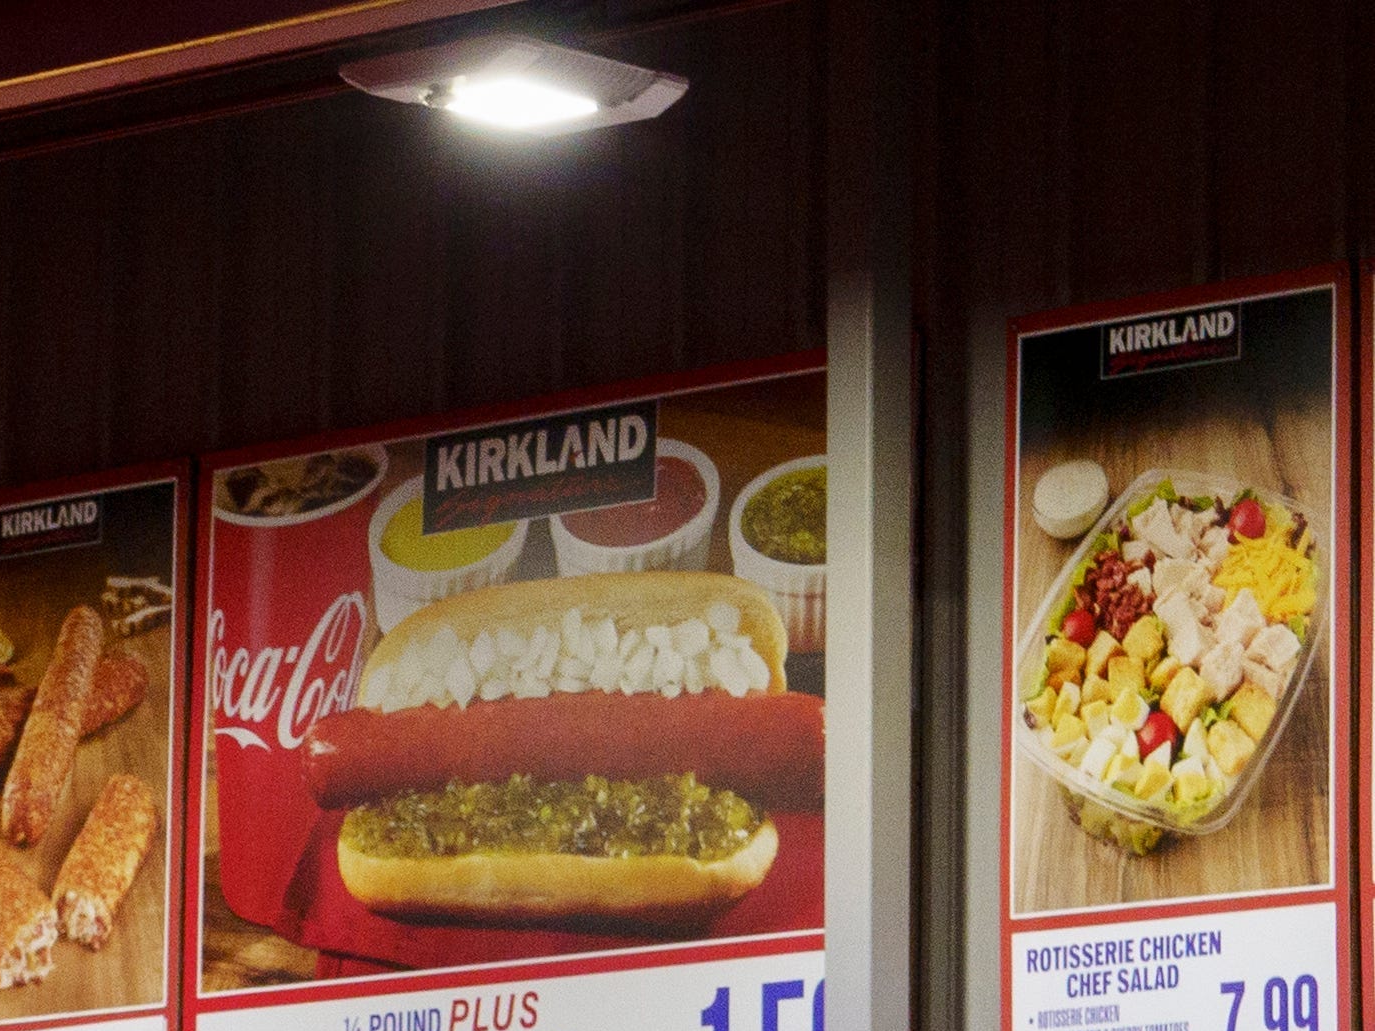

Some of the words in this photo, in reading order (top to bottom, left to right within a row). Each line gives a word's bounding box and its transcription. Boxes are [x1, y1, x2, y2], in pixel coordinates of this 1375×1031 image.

[1109, 311, 1235, 355] KIRKLAND
[436, 414, 647, 491] KIRKLAND
[1, 501, 98, 537] KIRKLAND
[1026, 939, 1134, 973] ROTISSERIE
[1139, 931, 1222, 961] CHICKEN
[1067, 971, 1112, 998] CHEF
[1117, 965, 1179, 994] SALAD
[1084, 1005, 1120, 1025] CHICKEN
